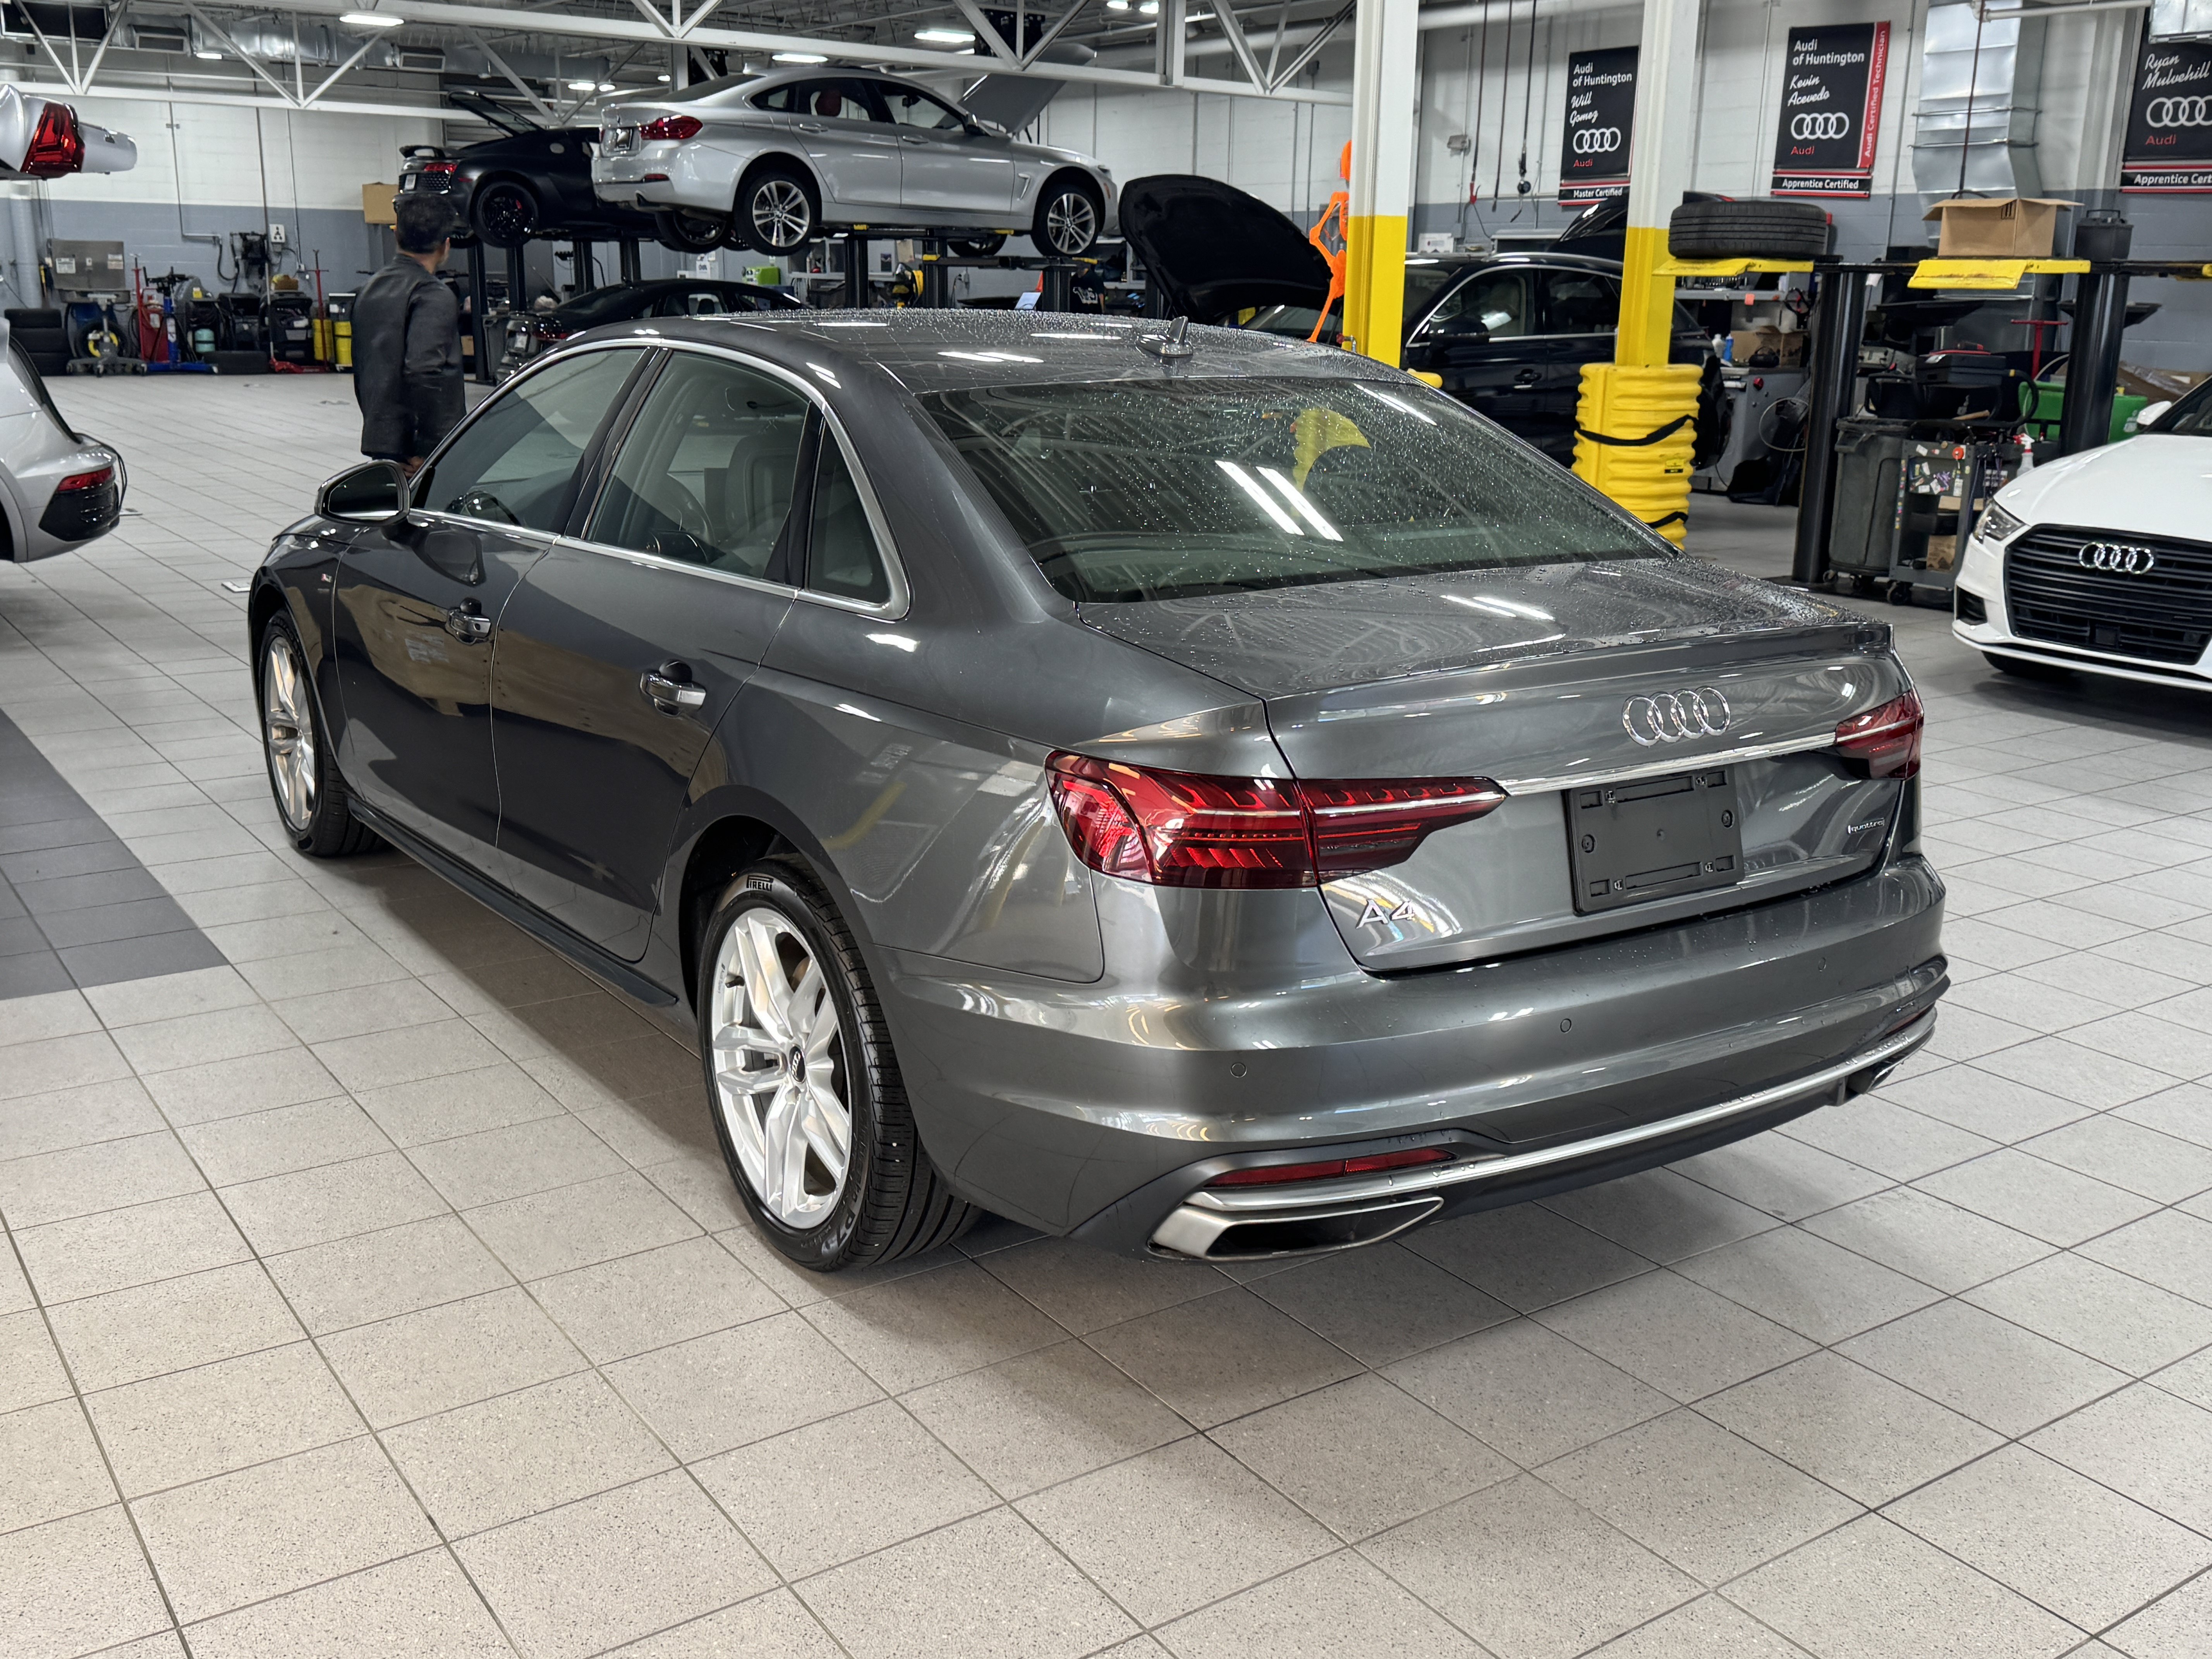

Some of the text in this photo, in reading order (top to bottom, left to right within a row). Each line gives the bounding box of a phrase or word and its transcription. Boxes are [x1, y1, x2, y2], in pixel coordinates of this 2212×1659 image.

[1793, 39, 1817, 52] Audi
[1793, 52, 1865, 66] of Huntington
[2145, 53, 2180, 74] Ryan
[1573, 62, 1593, 75] Audi
[1573, 73, 1632, 87] of Huntington
[1789, 74, 1820, 89] Kevin
[1571, 91, 1592, 108] Will
[1788, 86, 1830, 106] Acevedo
[1865, 31, 1886, 157] Audi Certified Technician
[1570, 110, 1599, 127] Gomez
[2145, 134, 2176, 146] Audi
[1791, 146, 1815, 155] Audi
[1573, 159, 1593, 168] Audi
[1782, 179, 1859, 189] Apprentice Certified
[2133, 173, 2212, 186] Apprentice Cert
[1573, 187, 1623, 198] Master Certified
[746, 874, 774, 892] PIRELLI
[1356, 898, 1415, 929] A4
